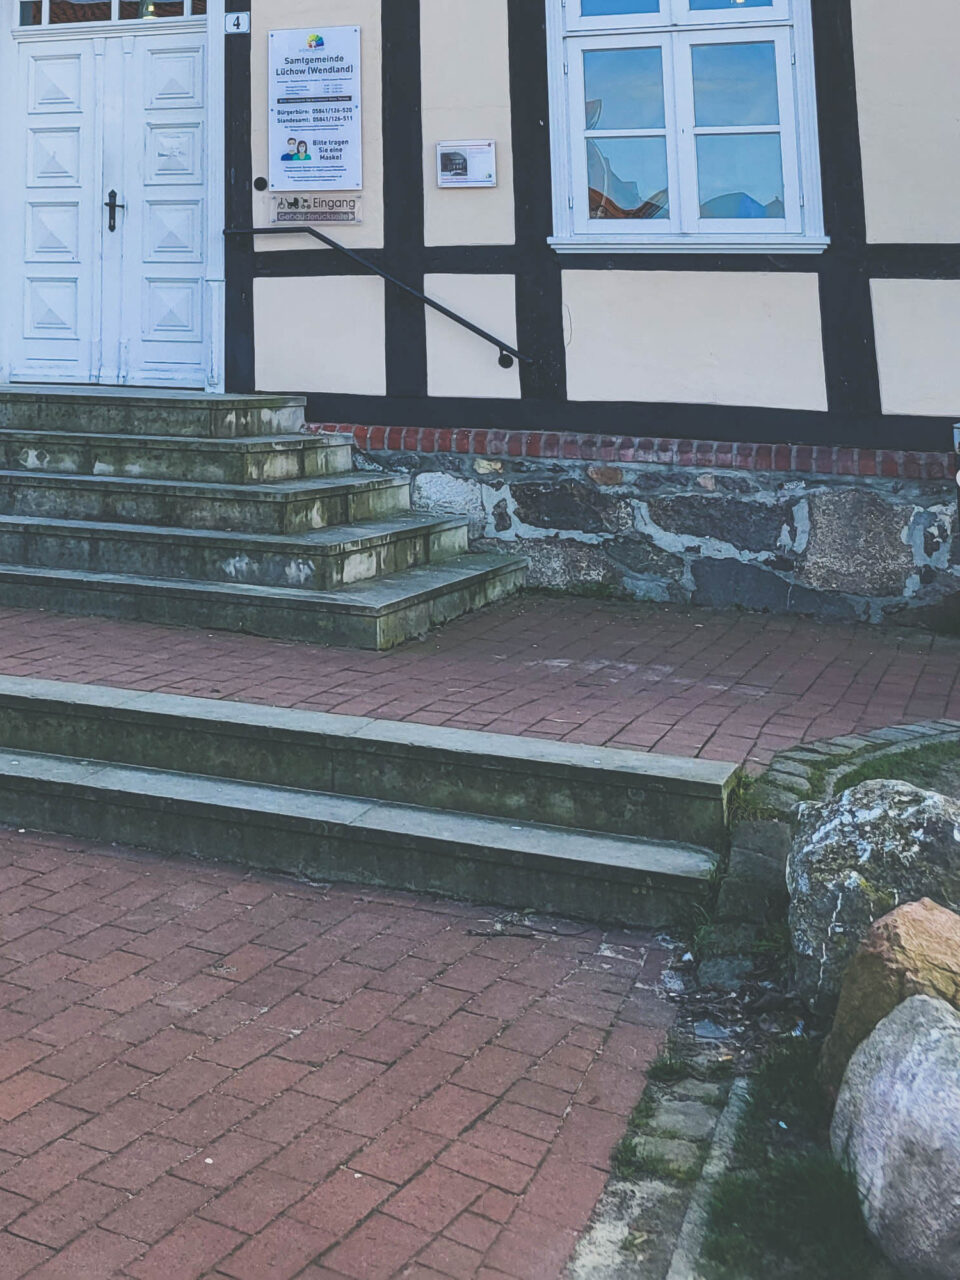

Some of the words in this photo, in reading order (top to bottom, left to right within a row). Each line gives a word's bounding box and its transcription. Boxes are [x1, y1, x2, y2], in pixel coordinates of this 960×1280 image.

[233, 15, 241, 30] 4
[284, 54, 344, 66] Samtgemeinde
[276, 67, 306, 76] Lüchow
[307, 64, 354, 75] (Wendland)
[328, 139, 349, 147] tragen
[313, 197, 356, 210] Eingang
